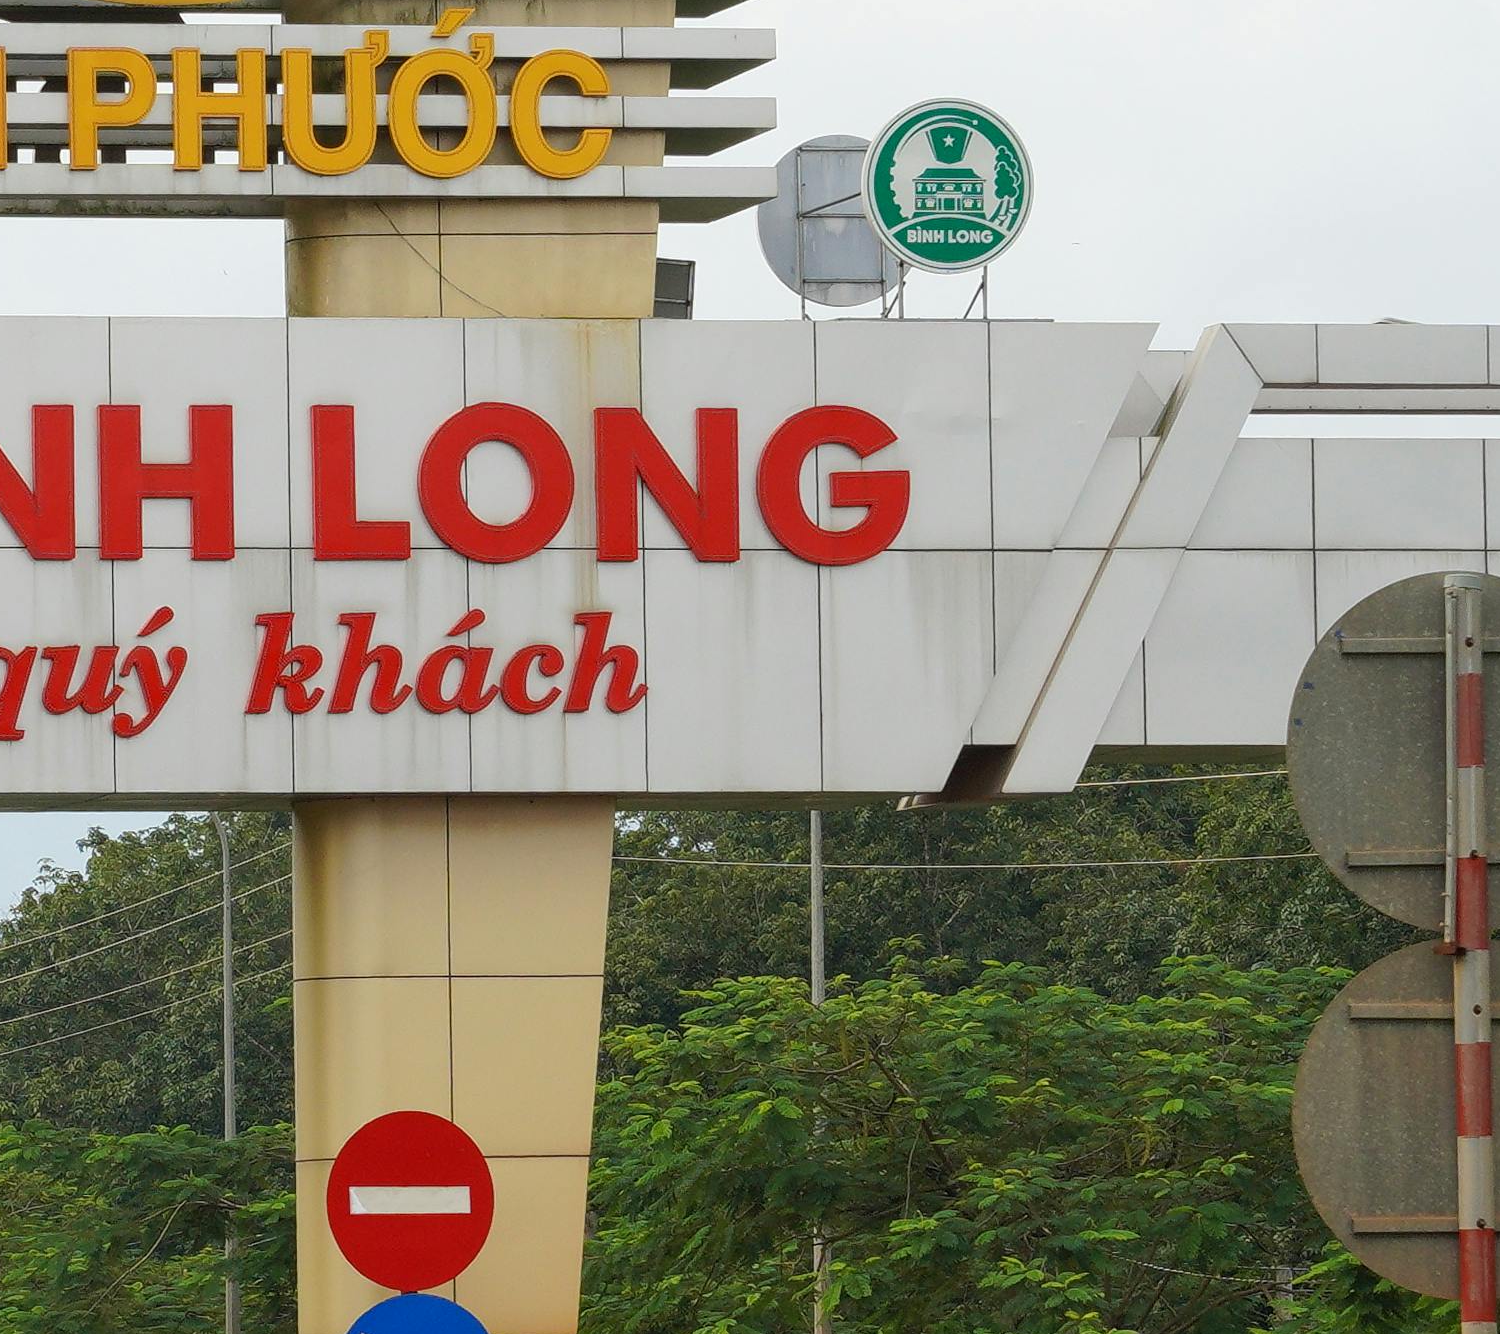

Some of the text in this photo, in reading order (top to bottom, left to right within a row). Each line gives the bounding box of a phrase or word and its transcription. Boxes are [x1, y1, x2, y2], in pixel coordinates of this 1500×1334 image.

[66, 6, 613, 178] PHƯỚC
[906, 226, 994, 244] BÌNH LONG
[310, 401, 911, 567] LONG
[244, 608, 649, 715] khách
